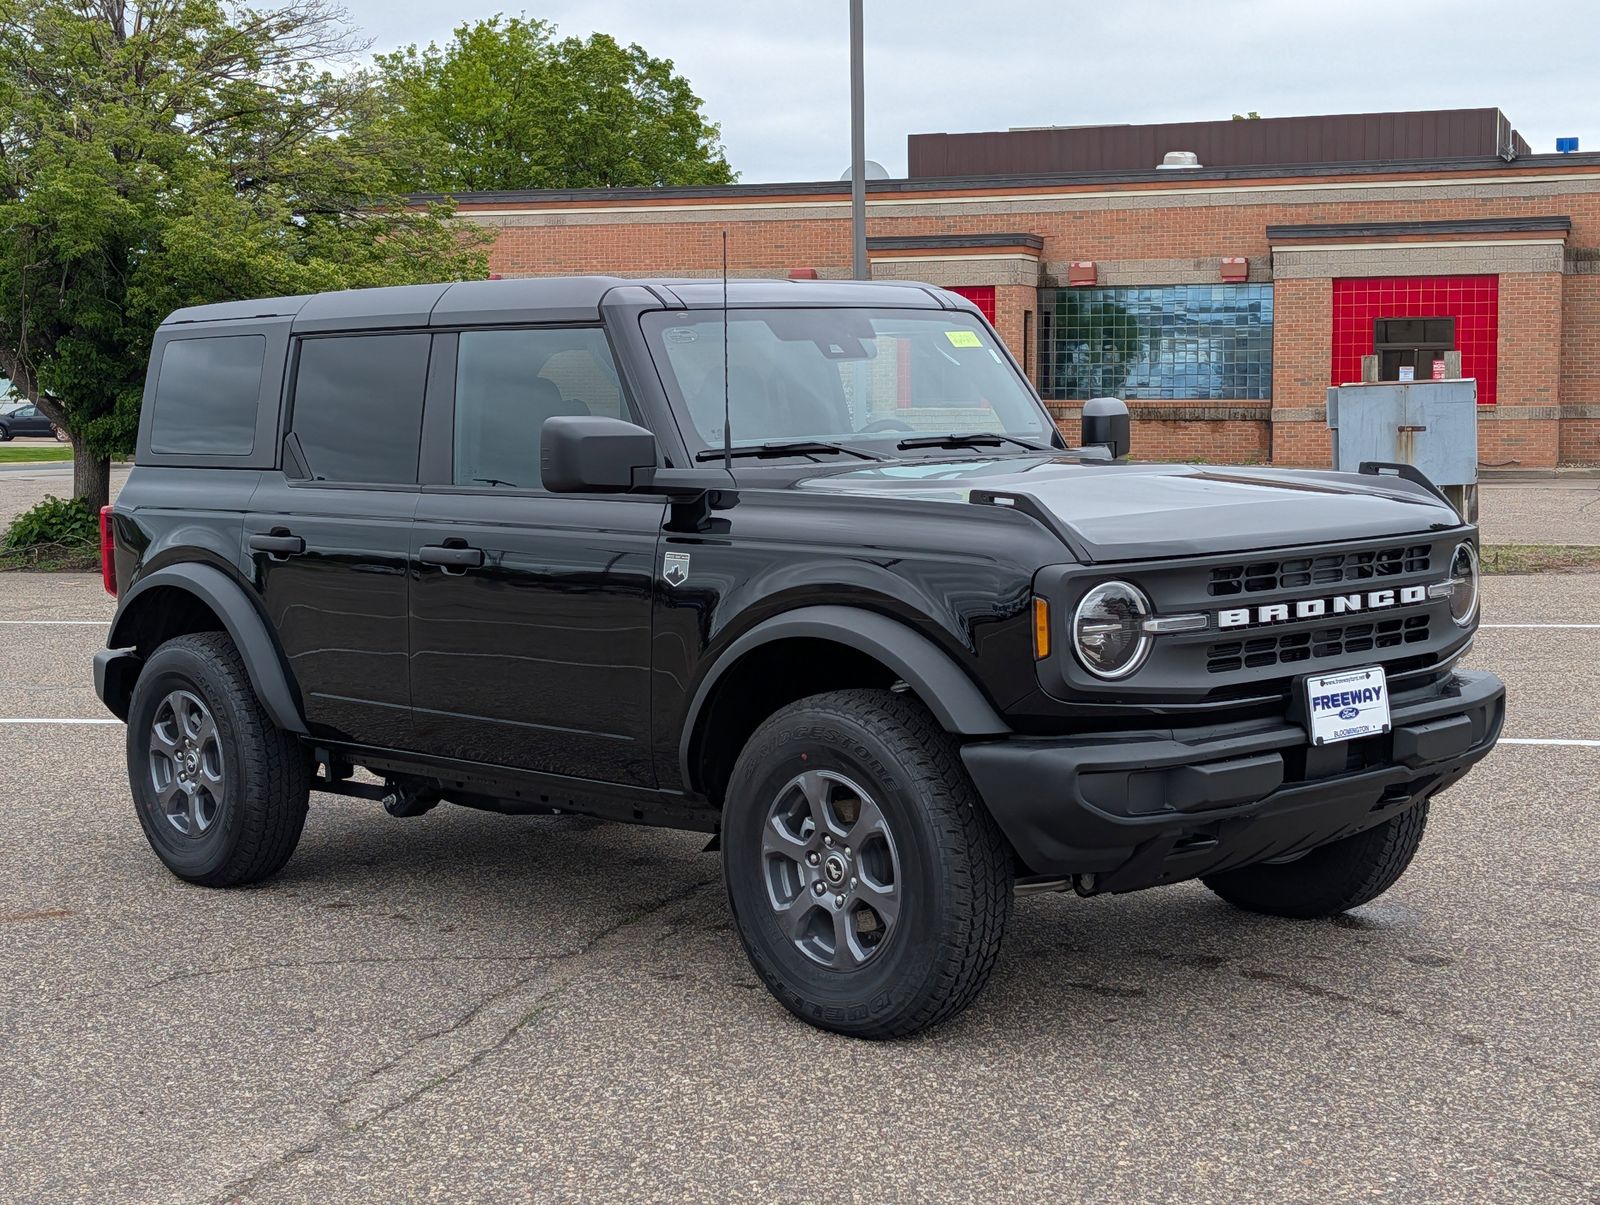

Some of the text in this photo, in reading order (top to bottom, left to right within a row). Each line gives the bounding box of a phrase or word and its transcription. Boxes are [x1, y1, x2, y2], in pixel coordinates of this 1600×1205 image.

[1218, 585, 1426, 628] BRONCO
[1312, 685, 1382, 712] FREEWAY
[1340, 708, 1357, 719] Ford
[1333, 725, 1370, 738] BLOOMINGTON
